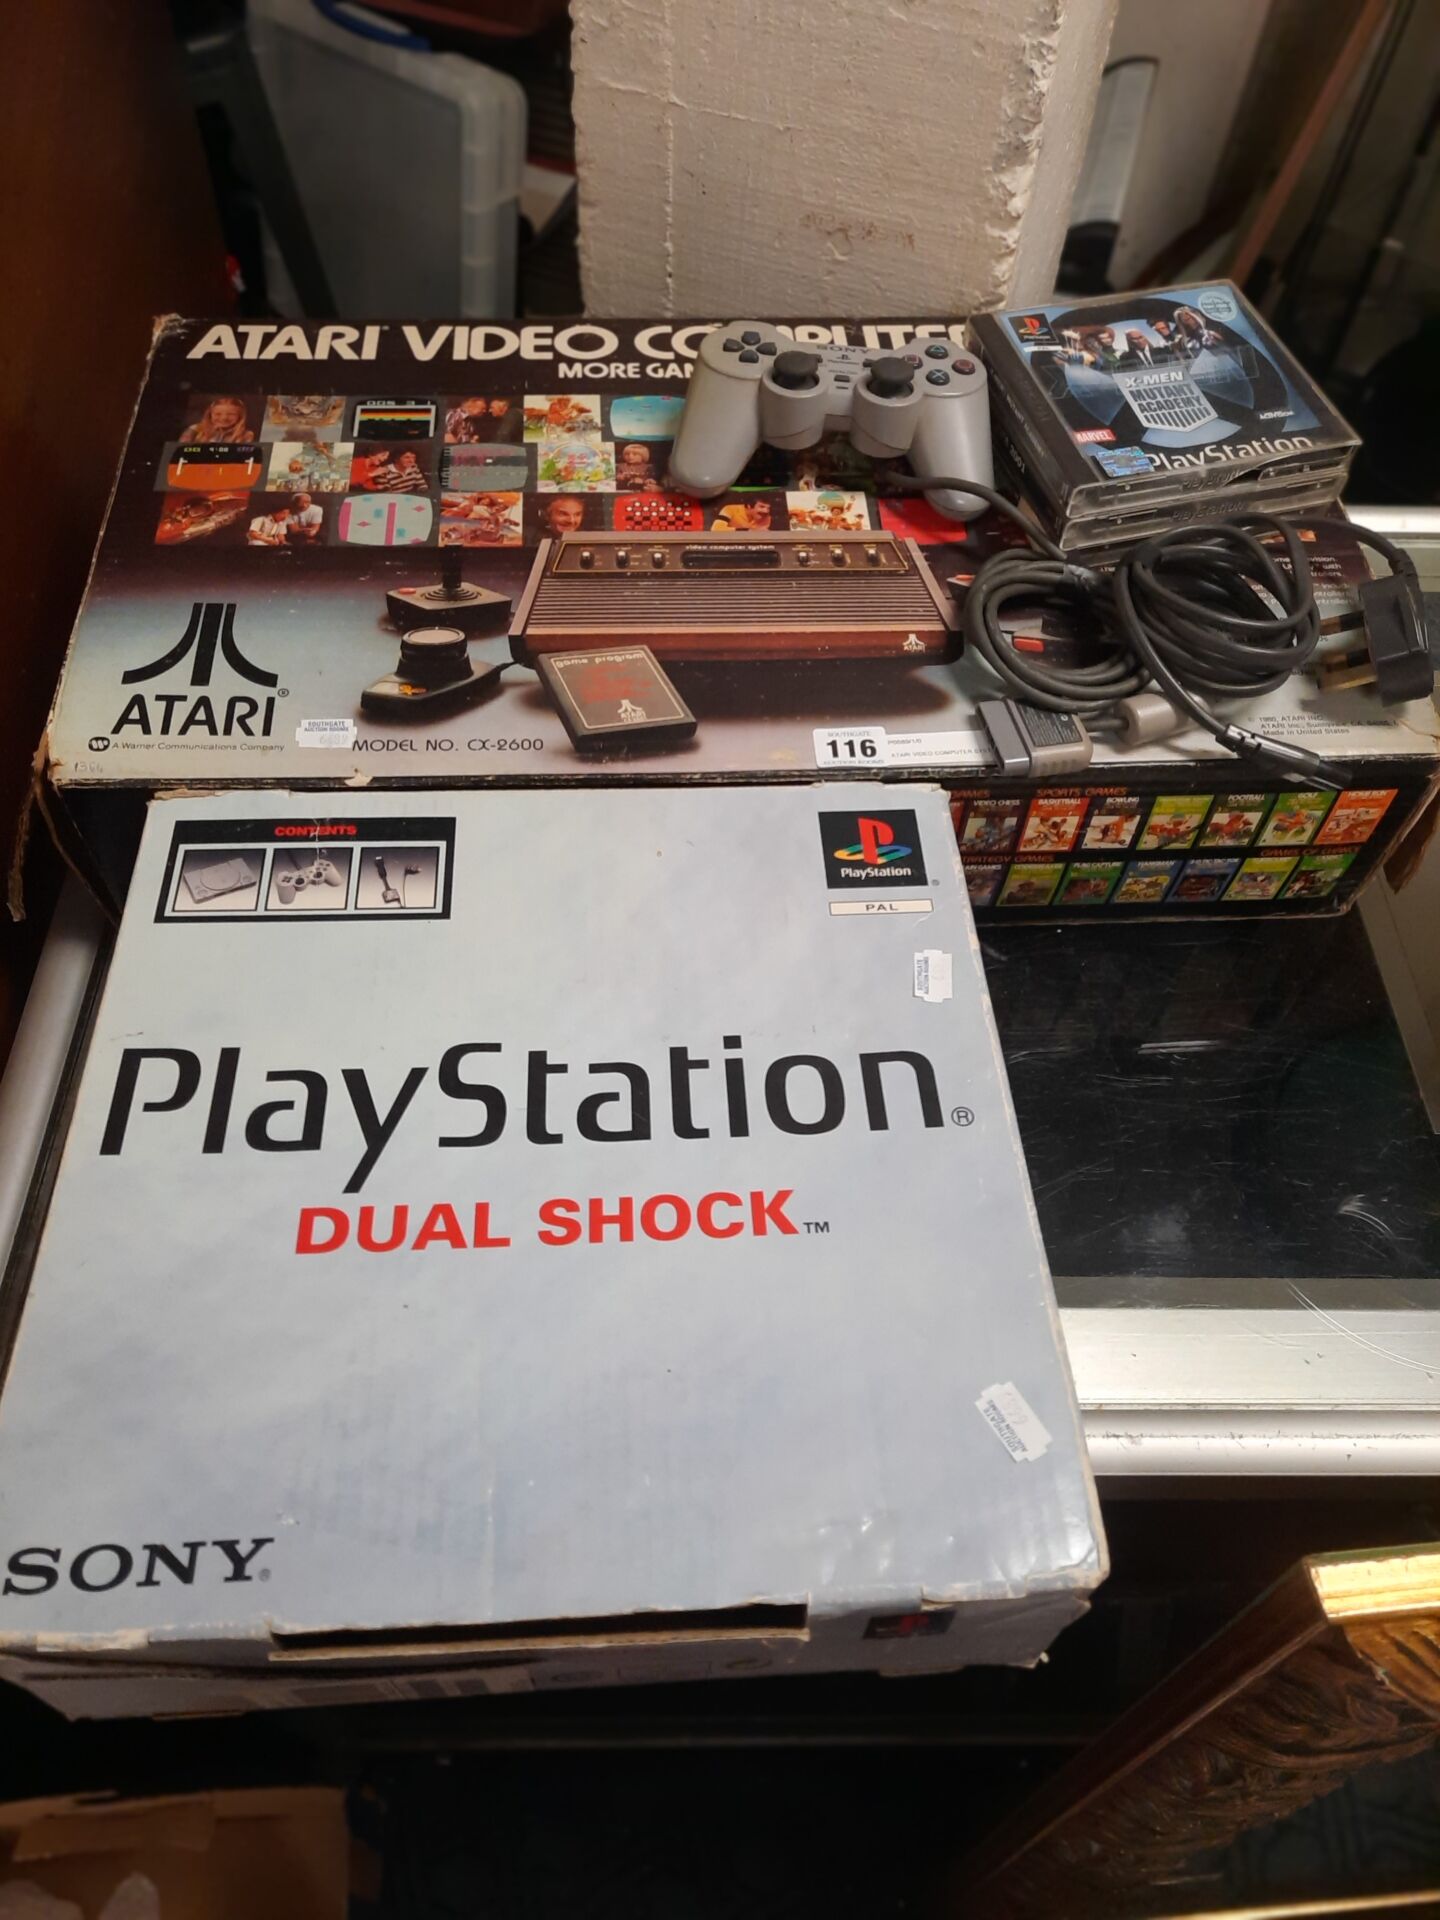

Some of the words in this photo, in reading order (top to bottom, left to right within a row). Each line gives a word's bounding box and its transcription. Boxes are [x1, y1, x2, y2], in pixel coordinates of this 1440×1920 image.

[186, 323, 383, 361] ATARI
[402, 323, 618, 362] VIDEO
[816, 344, 870, 354] SONY
[558, 363, 641, 379] MORE
[1125, 371, 1185, 388] X-MEN
[1128, 384, 1195, 403] MUTANT
[1137, 396, 1204, 414] ACADEMY
[1076, 431, 1112, 443] MARVEL
[555, 658, 589, 669] game
[594, 652, 645, 664] program
[111, 694, 276, 738] ATARI
[1325, 727, 1350, 735] States
[121, 742, 155, 750] Warner
[157, 742, 238, 751] Communications
[239, 743, 285, 752] Company
[352, 738, 418, 752] MODEL
[425, 738, 459, 752] NO.
[467, 737, 544, 752] CX-2600
[826, 739, 877, 759] 116
[1036, 788, 1082, 798] SPORTS
[1086, 787, 1130, 797] GAMES
[1228, 794, 1265, 802] FOOTBALL
[1037, 798, 1081, 806] BASKETBALL
[274, 825, 358, 836] CONTENTS
[961, 855, 1011, 864] TRATEGY
[1013, 854, 1055, 863] GAMES
[840, 865, 912, 881] PlayStation
[865, 903, 899, 912] PAL
[99, 1034, 946, 1194] PlayStation
[294, 1203, 512, 1256] DUAL
[536, 1188, 799, 1248] SHOCK
[2, 1537, 275, 1596] SONY
